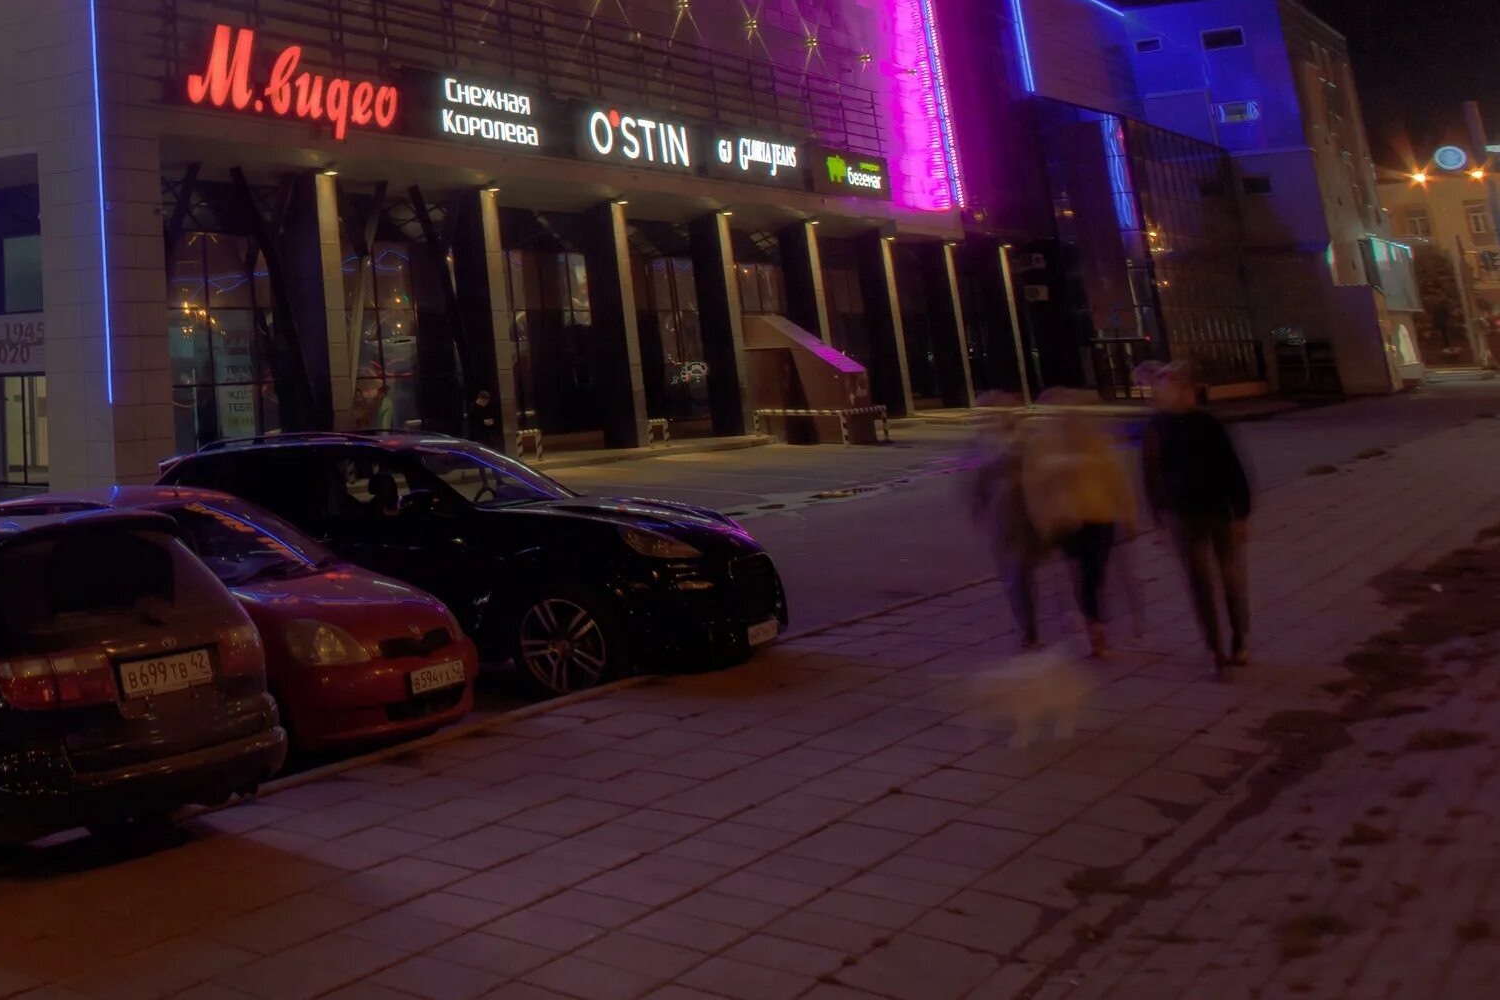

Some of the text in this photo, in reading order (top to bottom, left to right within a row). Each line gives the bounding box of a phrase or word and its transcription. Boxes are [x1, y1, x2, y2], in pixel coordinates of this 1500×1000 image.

[187, 24, 399, 140] М.видео
[444, 78, 532, 116] Снежная
[442, 109, 540, 147] Королева
[590, 109, 690, 167] O'STIN
[3, 321, 45, 341] 1945
